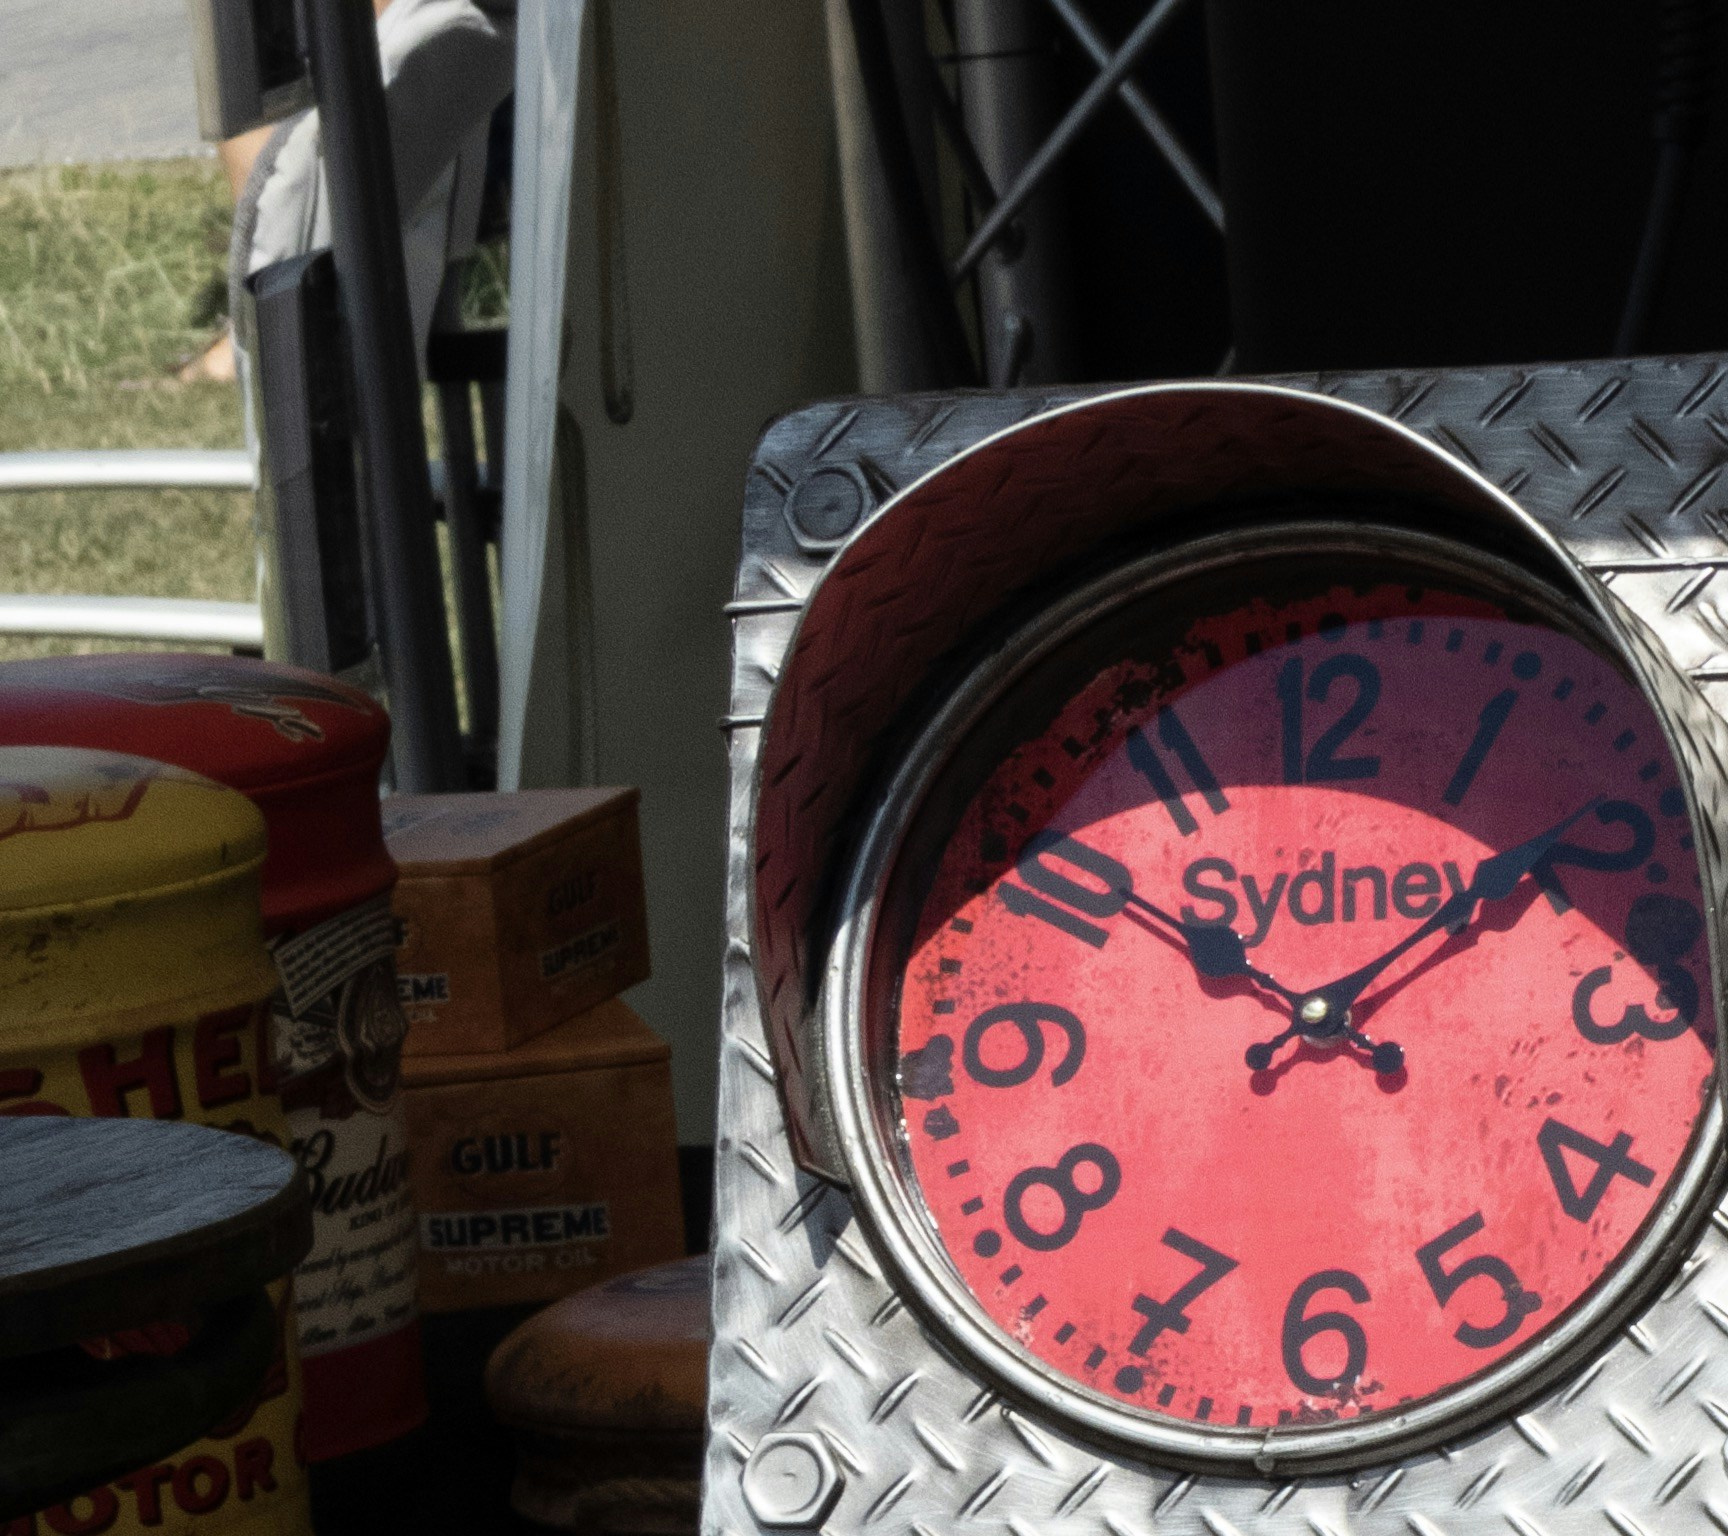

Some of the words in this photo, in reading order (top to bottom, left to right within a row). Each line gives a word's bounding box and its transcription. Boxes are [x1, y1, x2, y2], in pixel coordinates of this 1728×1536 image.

[1126, 704, 1229, 836] 11
[1277, 653, 1381, 784] 12
[1442, 686, 1519, 805] 1
[999, 829, 1134, 950] 10
[1180, 851, 1481, 947] Sydney
[1528, 799, 1656, 914] 2
[962, 1001, 1087, 1089] 9
[1571, 964, 1698, 1047] 3
[451, 1131, 562, 1173] GULF
[1003, 1142, 1122, 1253] 8
[1537, 1115, 1658, 1224] 4
[429, 1206, 609, 1247] SUPREME
[446, 1253, 546, 1276] MOTOR
[555, 1246, 598, 1267] OIL
[1415, 1210, 1528, 1349] 5
[1129, 1226, 1240, 1358] 7
[1280, 1269, 1372, 1397] 6
